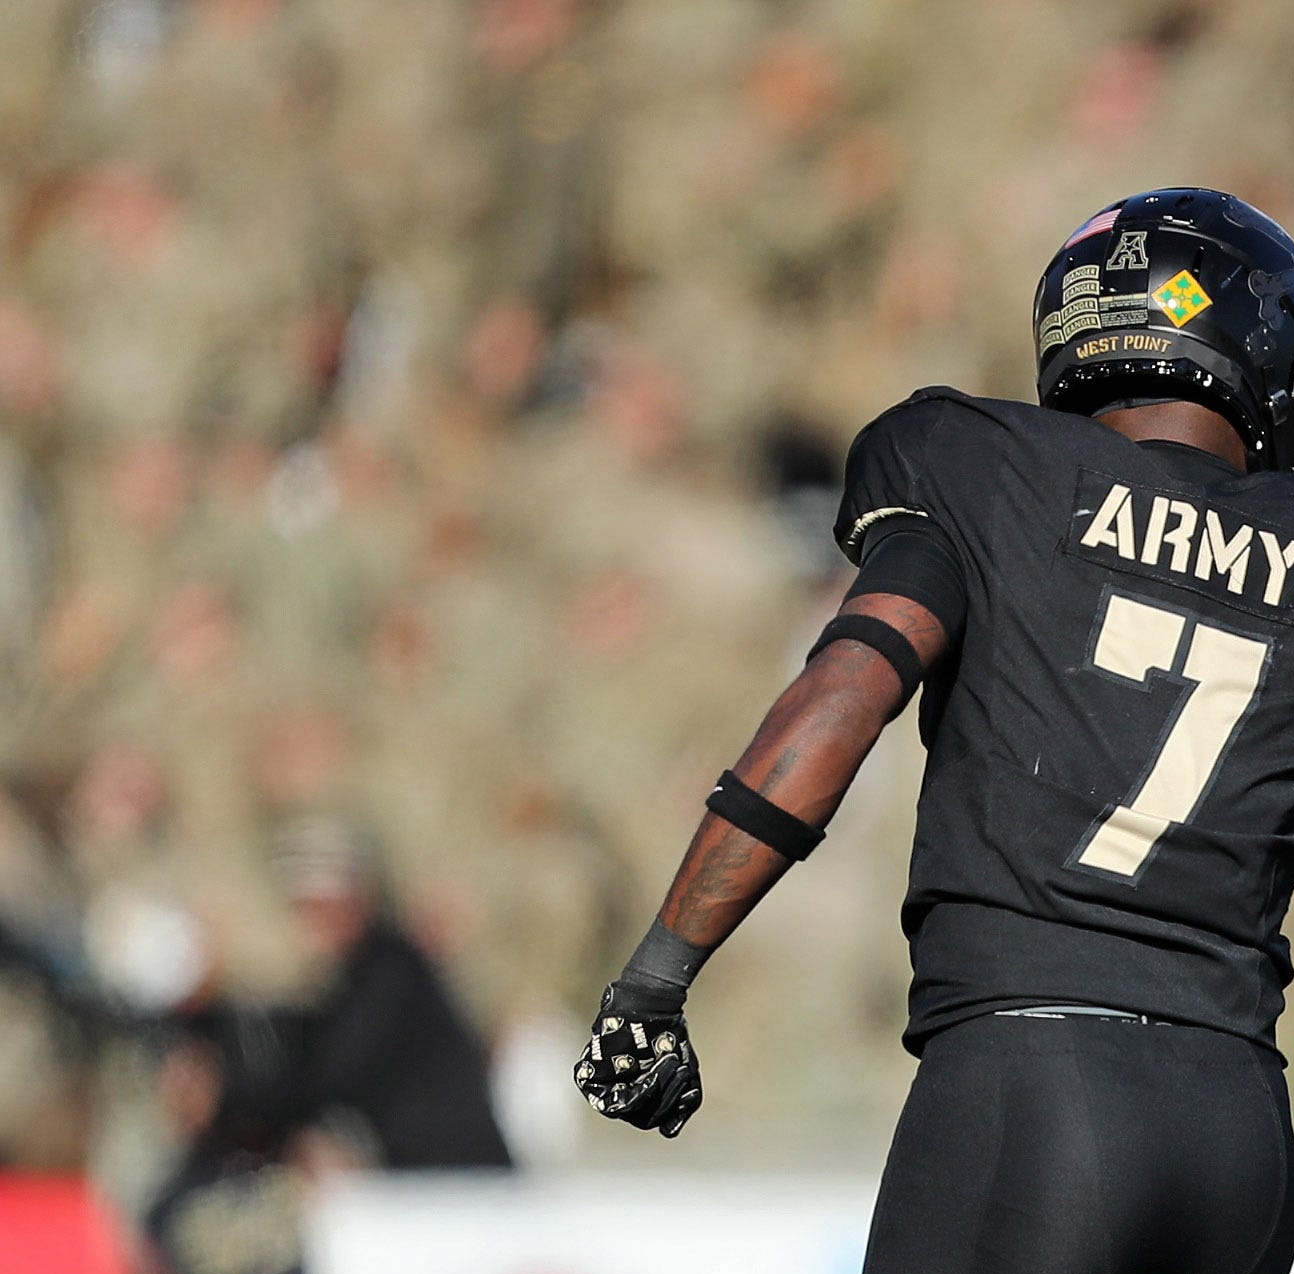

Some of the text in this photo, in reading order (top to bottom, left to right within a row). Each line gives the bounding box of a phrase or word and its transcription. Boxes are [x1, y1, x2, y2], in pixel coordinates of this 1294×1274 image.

[1076, 336, 1119, 359] WEST
[1123, 335, 1172, 353] POINT
[1078, 594, 1268, 877] 7
